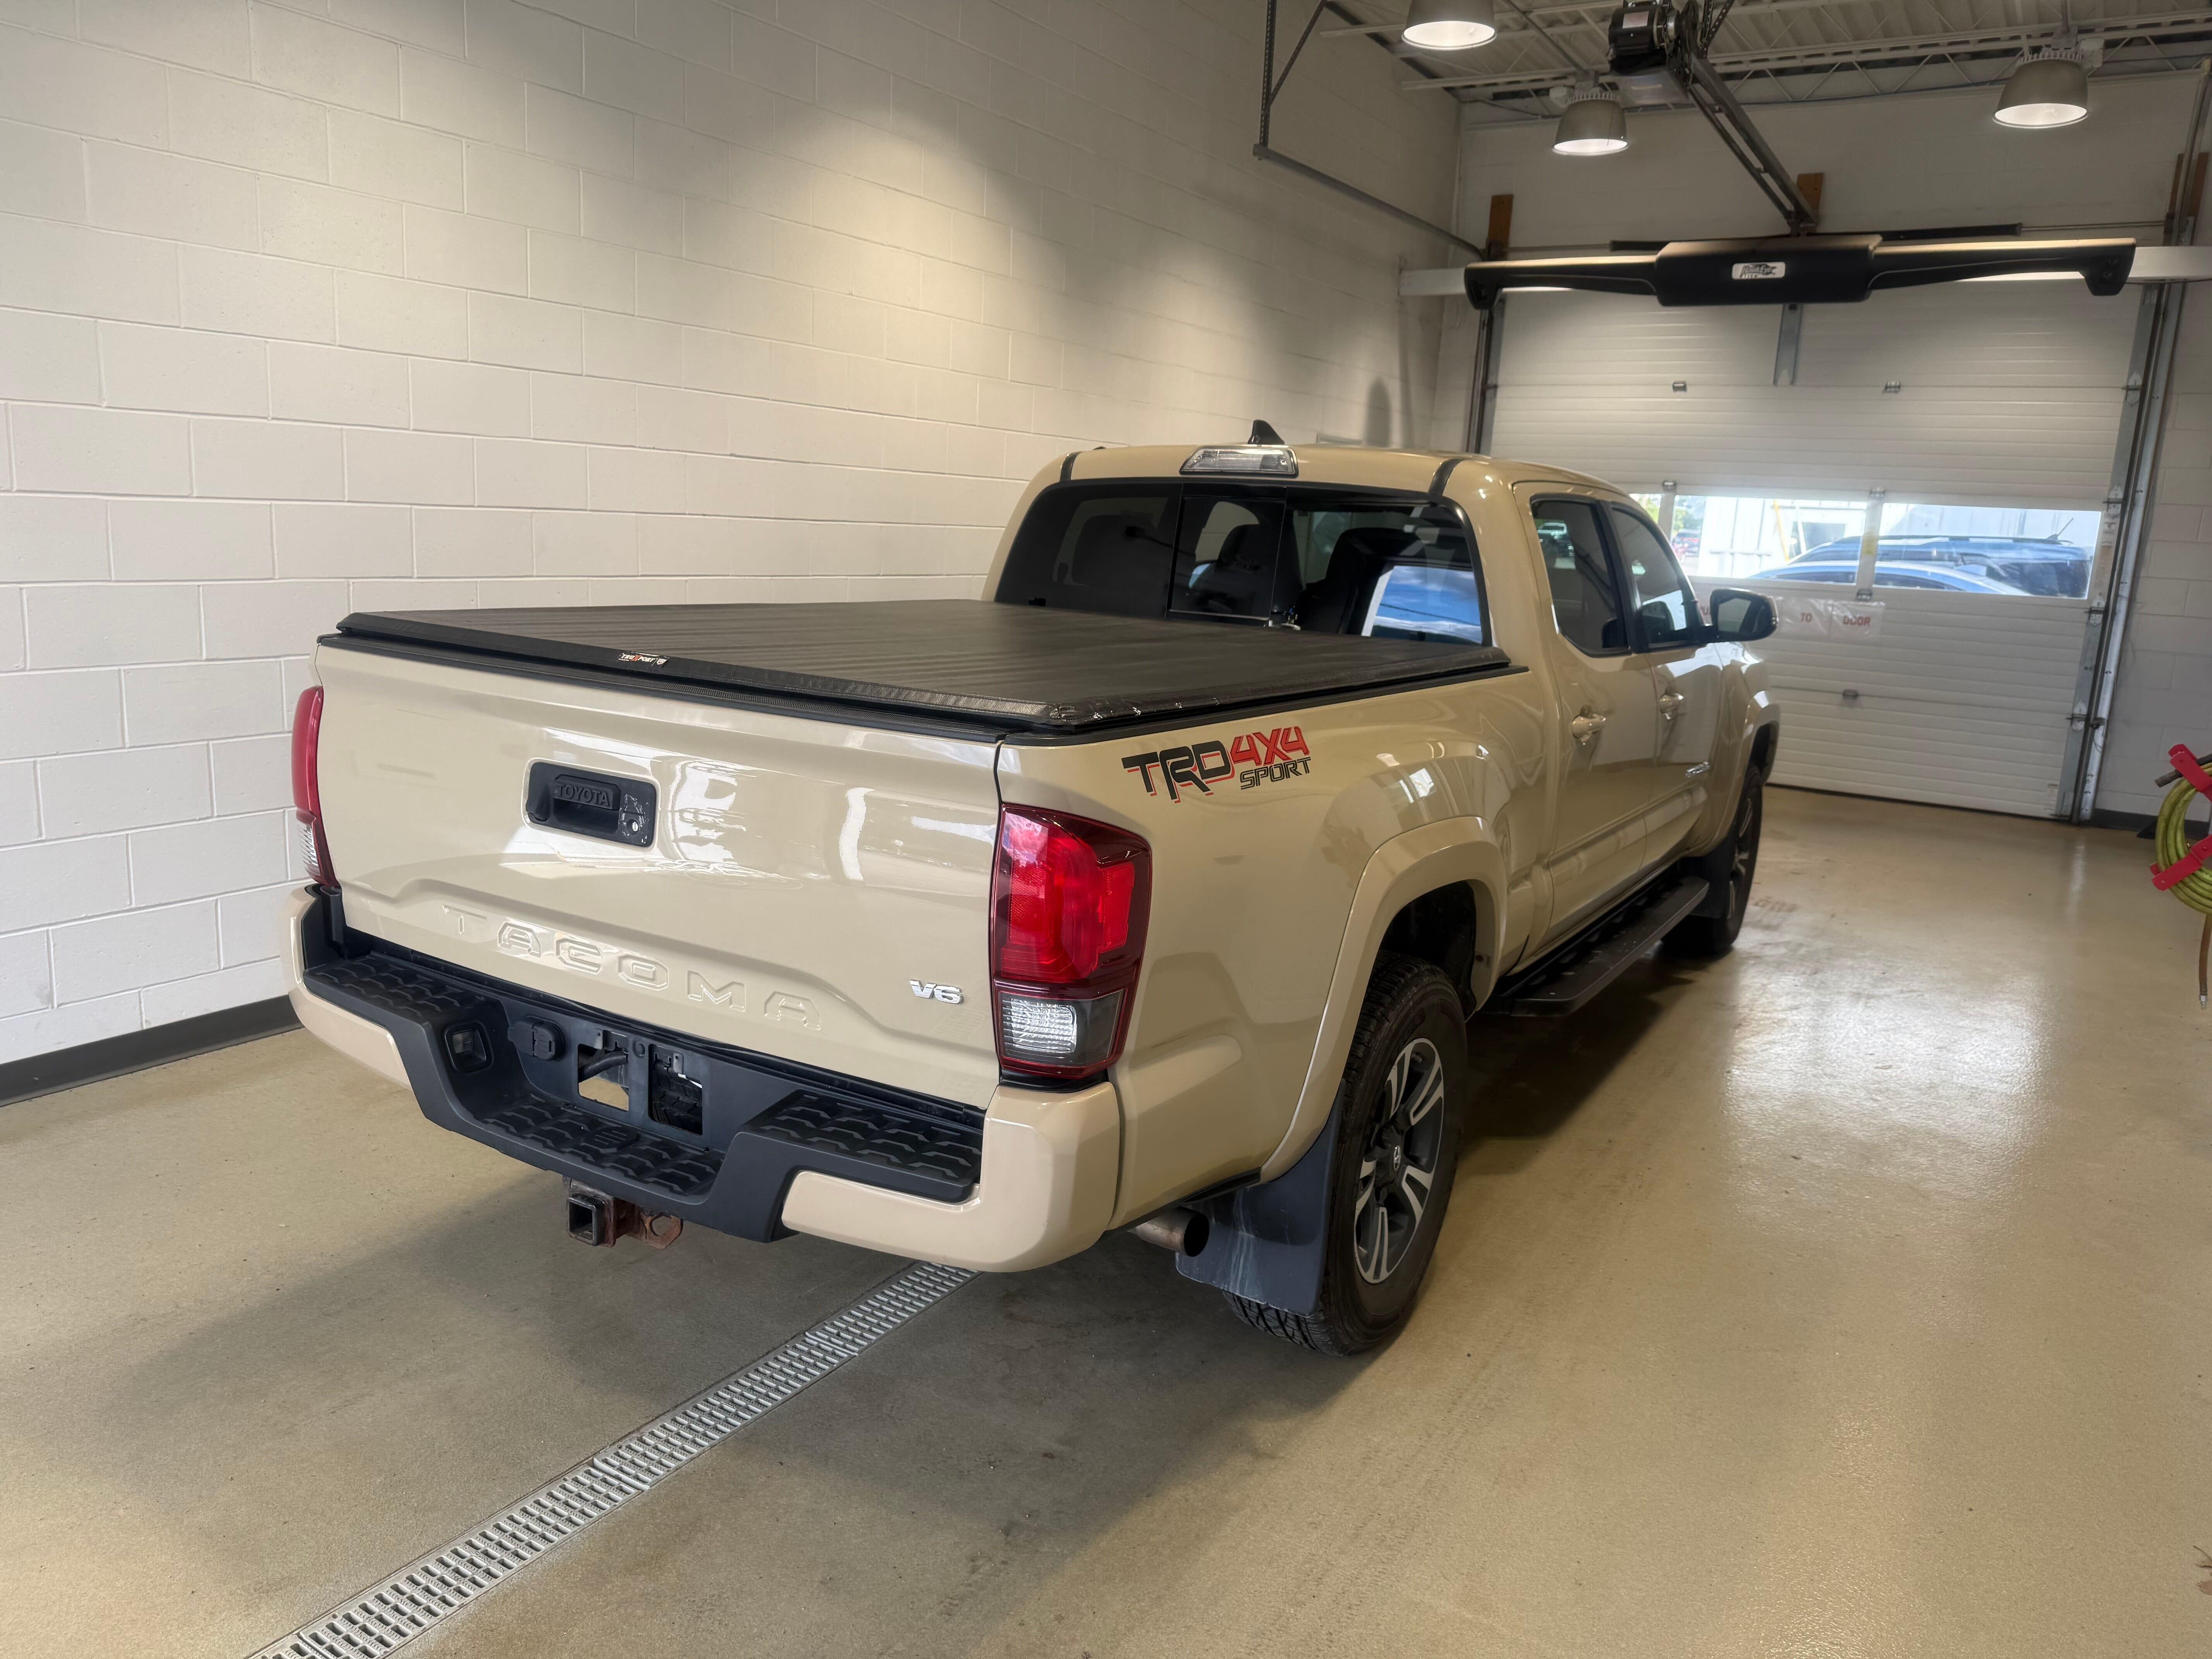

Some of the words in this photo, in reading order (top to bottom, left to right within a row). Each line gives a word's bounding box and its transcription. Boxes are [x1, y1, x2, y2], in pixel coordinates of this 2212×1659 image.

[1800, 612, 1813, 623] TO
[1843, 615, 1872, 626] DOOR
[621, 653, 655, 662] TRUXPORT
[1121, 740, 1235, 804] TRD
[1240, 757, 1311, 790] SPORT
[557, 783, 611, 807] TOYOTA
[442, 904, 821, 1031] TACOMA
[909, 979, 964, 1004] V6
